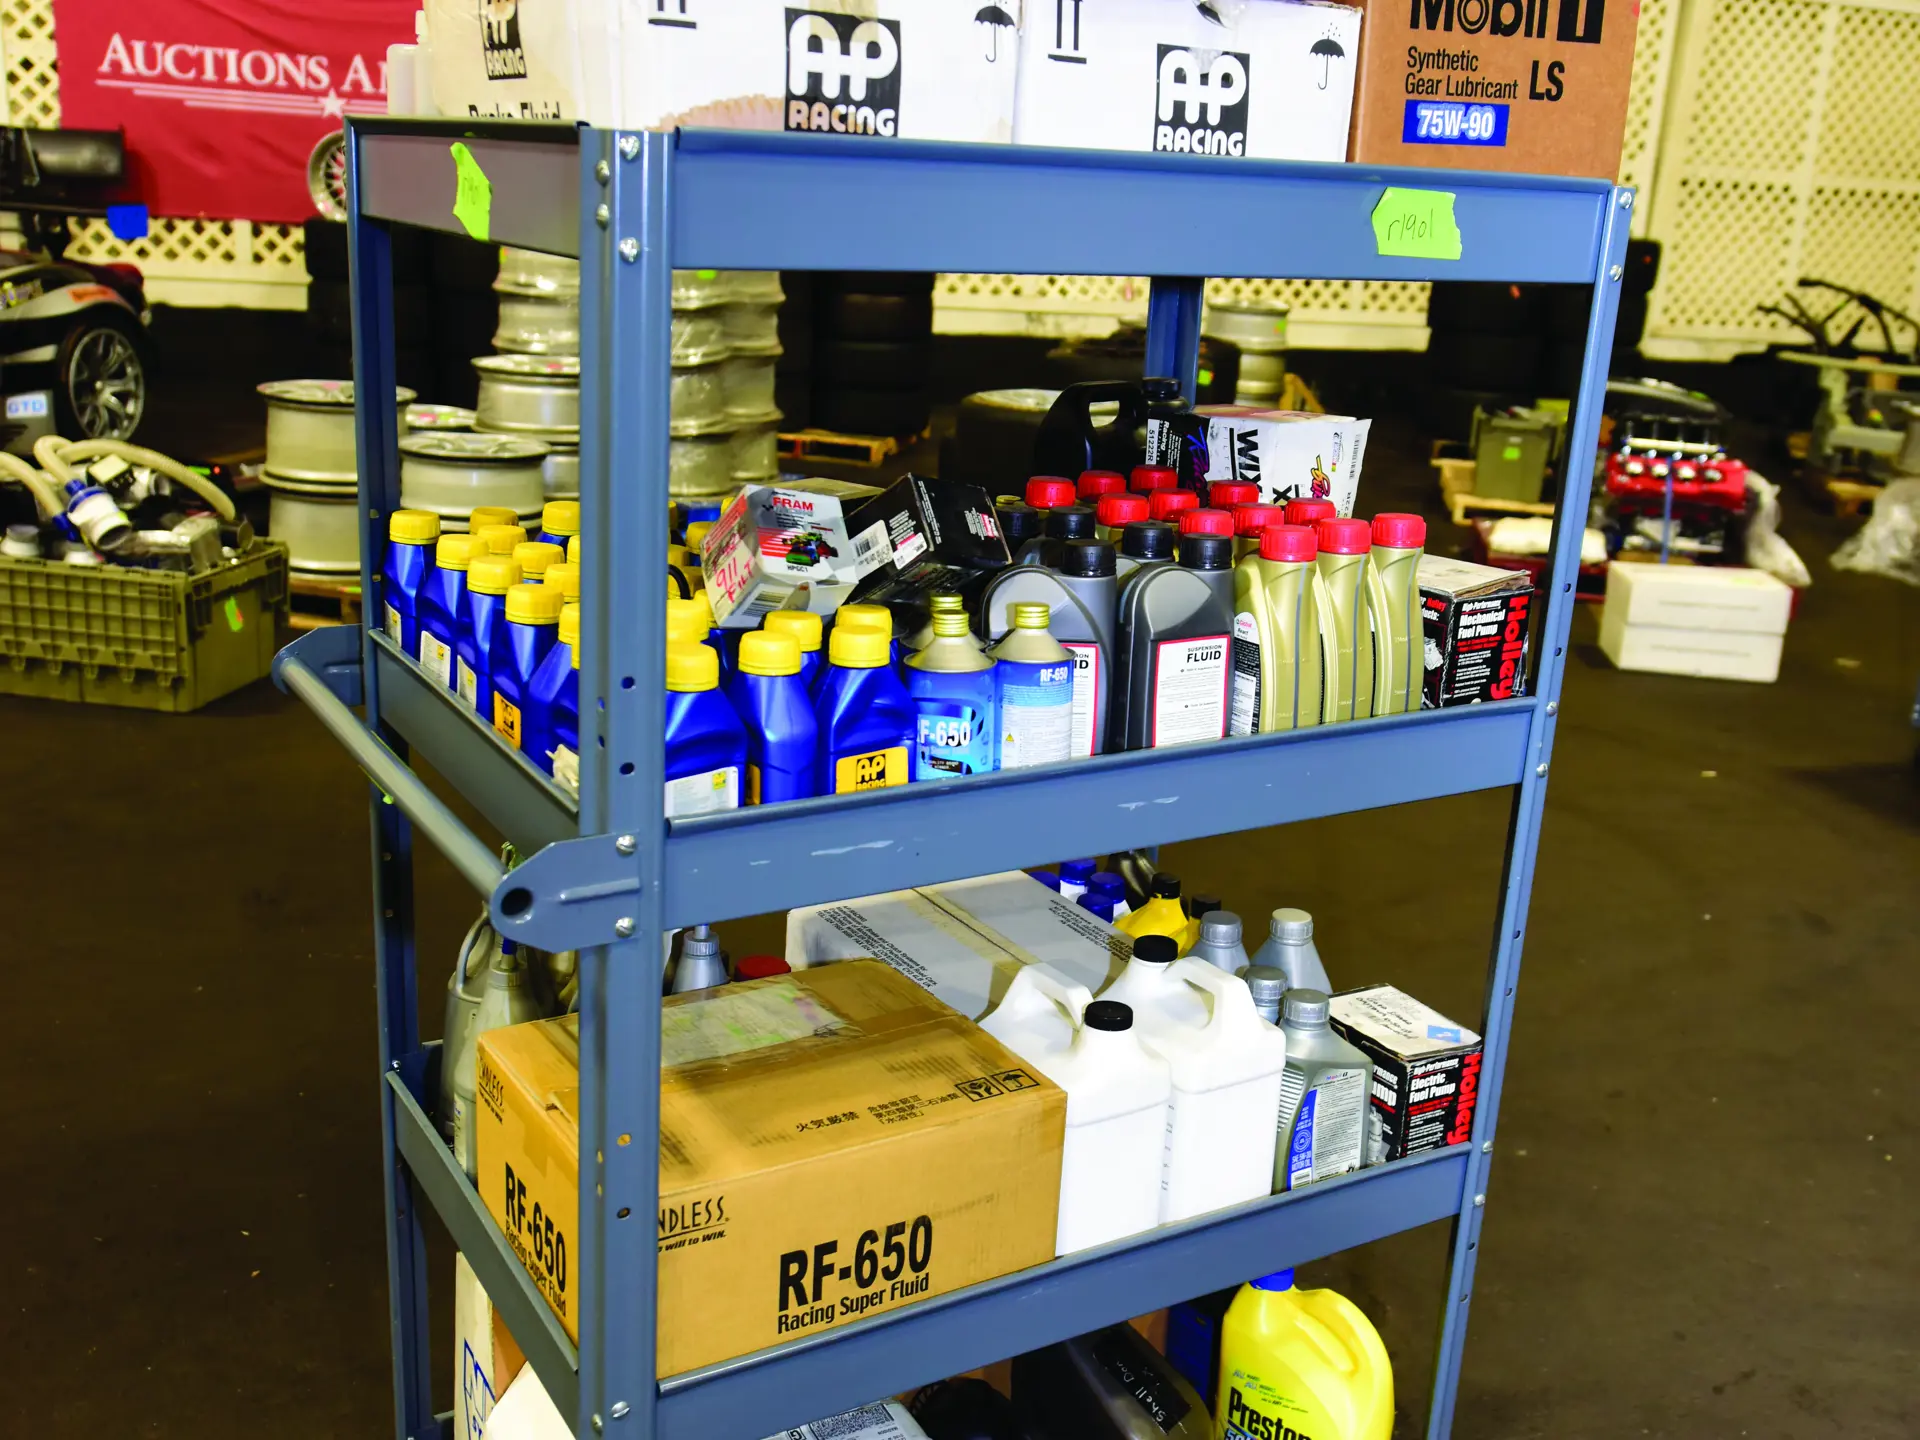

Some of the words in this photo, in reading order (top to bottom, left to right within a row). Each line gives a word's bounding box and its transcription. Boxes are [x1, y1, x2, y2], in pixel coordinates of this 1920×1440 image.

[1410, 0, 1548, 38] Mobil
[97, 31, 331, 90] AUCTIONS
[789, 14, 898, 101] AP
[1407, 46, 1479, 73] Synthetic
[1158, 48, 1247, 127] AP
[1405, 72, 1442, 96] Gear
[1446, 74, 1519, 100] Lubricant
[1529, 60, 1565, 101] LS
[788, 100, 896, 138] RACING
[1418, 107, 1495, 138] 75W-90
[1156, 124, 1244, 157] RACING
[1147, 429, 1156, 462] 51222R
[1237, 429, 1263, 494] WIX
[773, 495, 813, 512] FRAM
[1459, 609, 1506, 627] Mechanical
[1462, 599, 1502, 612] High-Performance
[1187, 644, 1223, 653] SUSPENSION
[1457, 626, 1475, 640] Fuel
[1475, 624, 1498, 637] Pump
[1490, 595, 1529, 700] Holley
[1186, 650, 1222, 663] FLUID
[1040, 665, 1069, 683] RF-650
[857, 755, 885, 782] AP
[1409, 1086, 1428, 1104] Fuel
[1430, 1082, 1457, 1099] Pump
[1411, 1073, 1447, 1091] Electric
[1446, 1052, 1483, 1146] Holley
[505, 1161, 566, 1294] RF-650
[658, 1195, 728, 1234] NDLESS
[505, 1218, 527, 1267] Racing
[528, 1250, 548, 1289] Super
[665, 1239, 687, 1251] will
[687, 1237, 700, 1246] to
[701, 1230, 726, 1243] WIN.
[778, 1214, 933, 1313] RF-650
[777, 1304, 836, 1335] Racing
[839, 1288, 887, 1315] Super
[890, 1271, 930, 1301] Fluid
[1135, 1386, 1167, 1422] Shell
